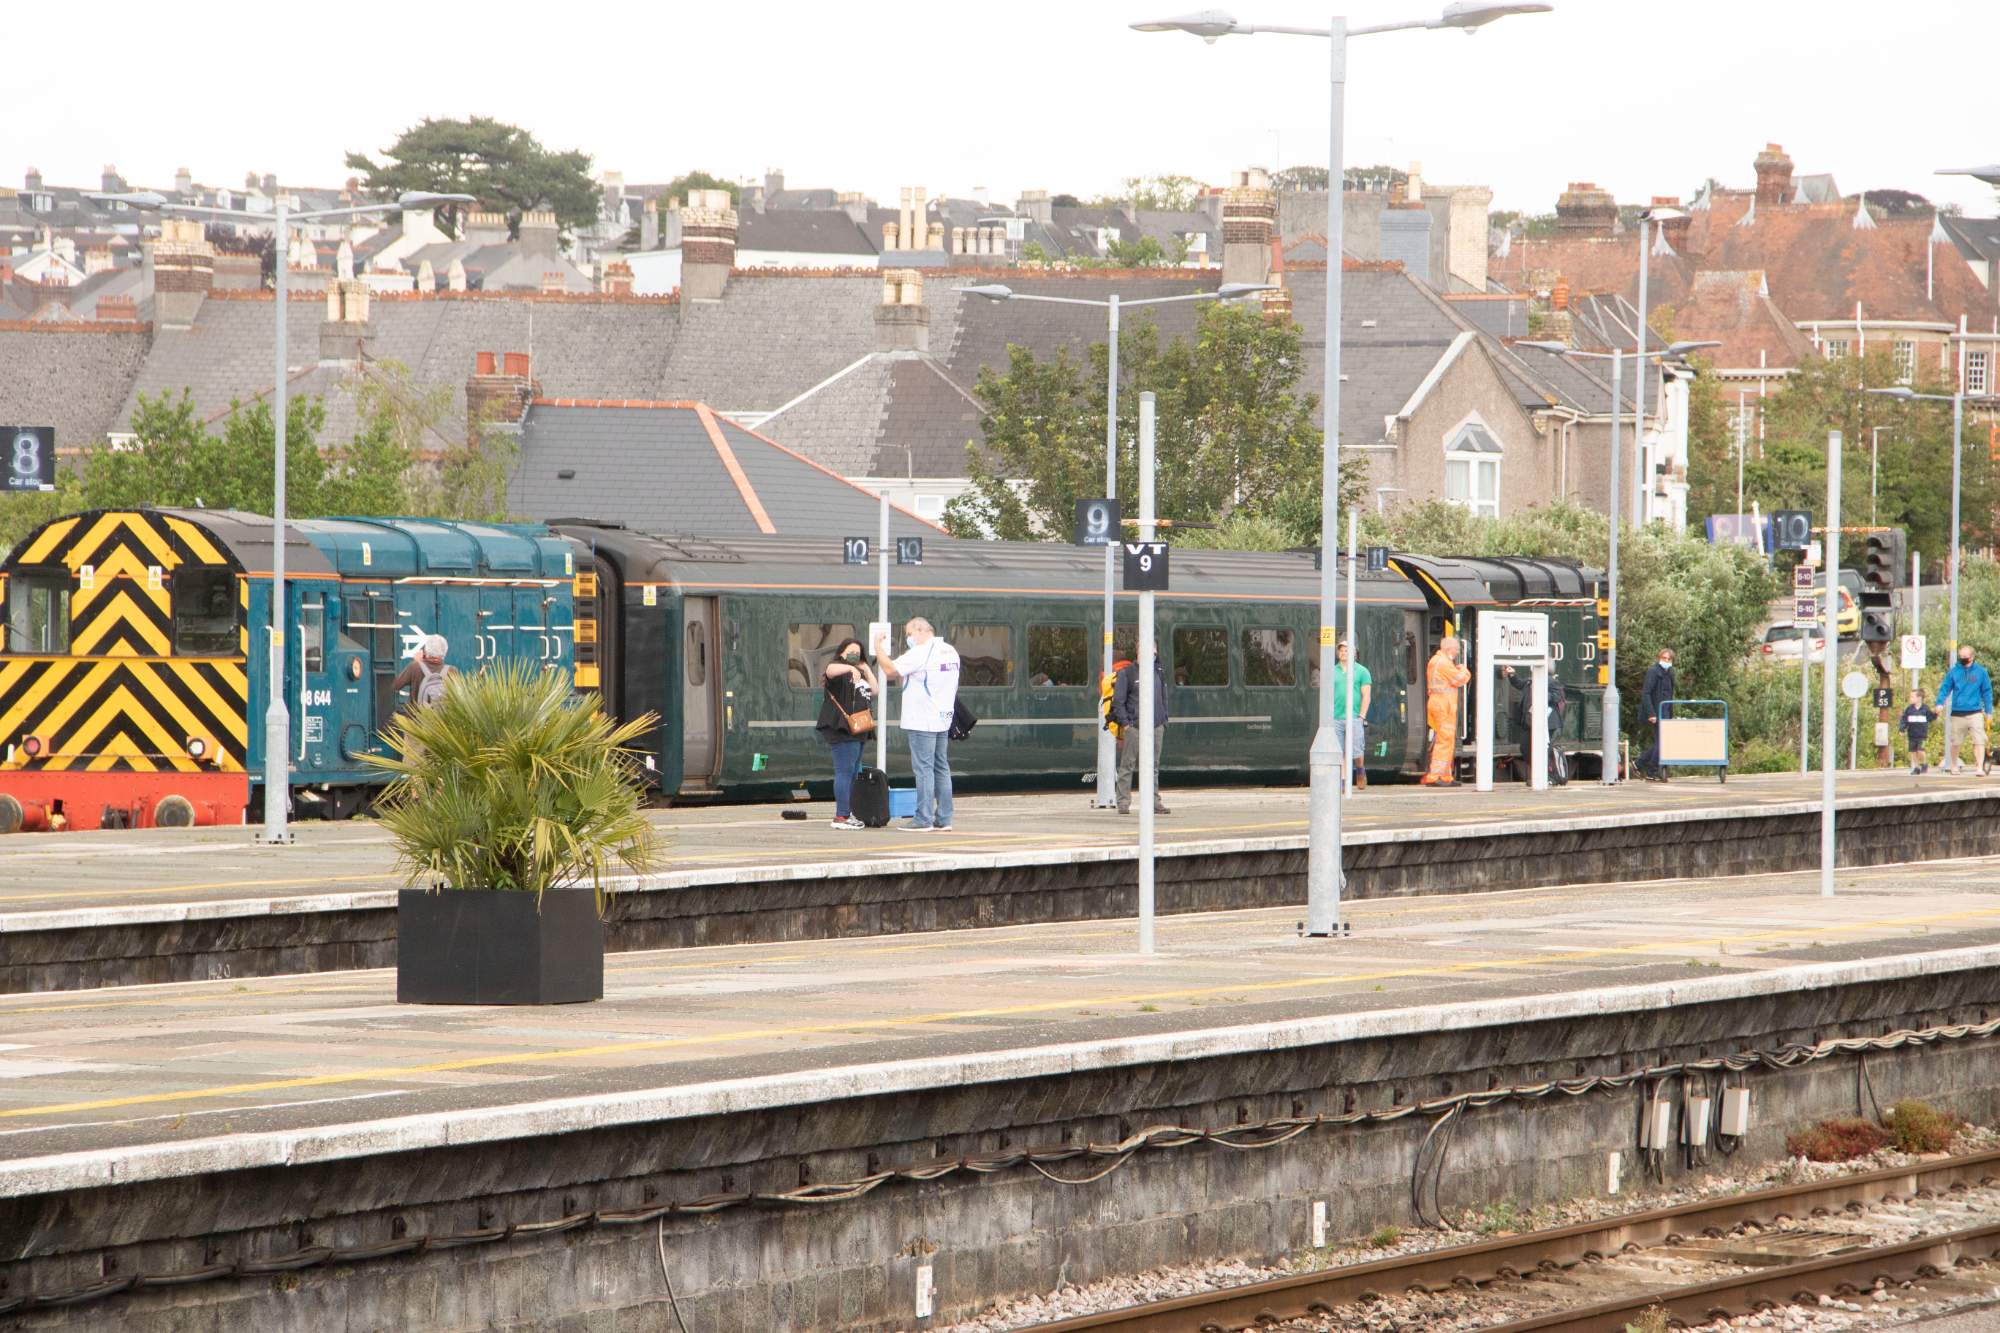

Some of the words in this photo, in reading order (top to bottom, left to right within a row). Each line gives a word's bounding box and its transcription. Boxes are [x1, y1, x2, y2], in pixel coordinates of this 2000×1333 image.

[12, 432, 40, 474] 8
[8, 476, 24, 486] Car
[1087, 502, 1109, 535] 9
[1776, 514, 1809, 541] 10
[845, 539, 867, 558] 10
[899, 540, 920, 558] 10
[1140, 554, 1152, 572] 9
[1500, 624, 1538, 652] Plymouth
[314, 690, 331, 706] 644
[1879, 689, 1887, 698] P
